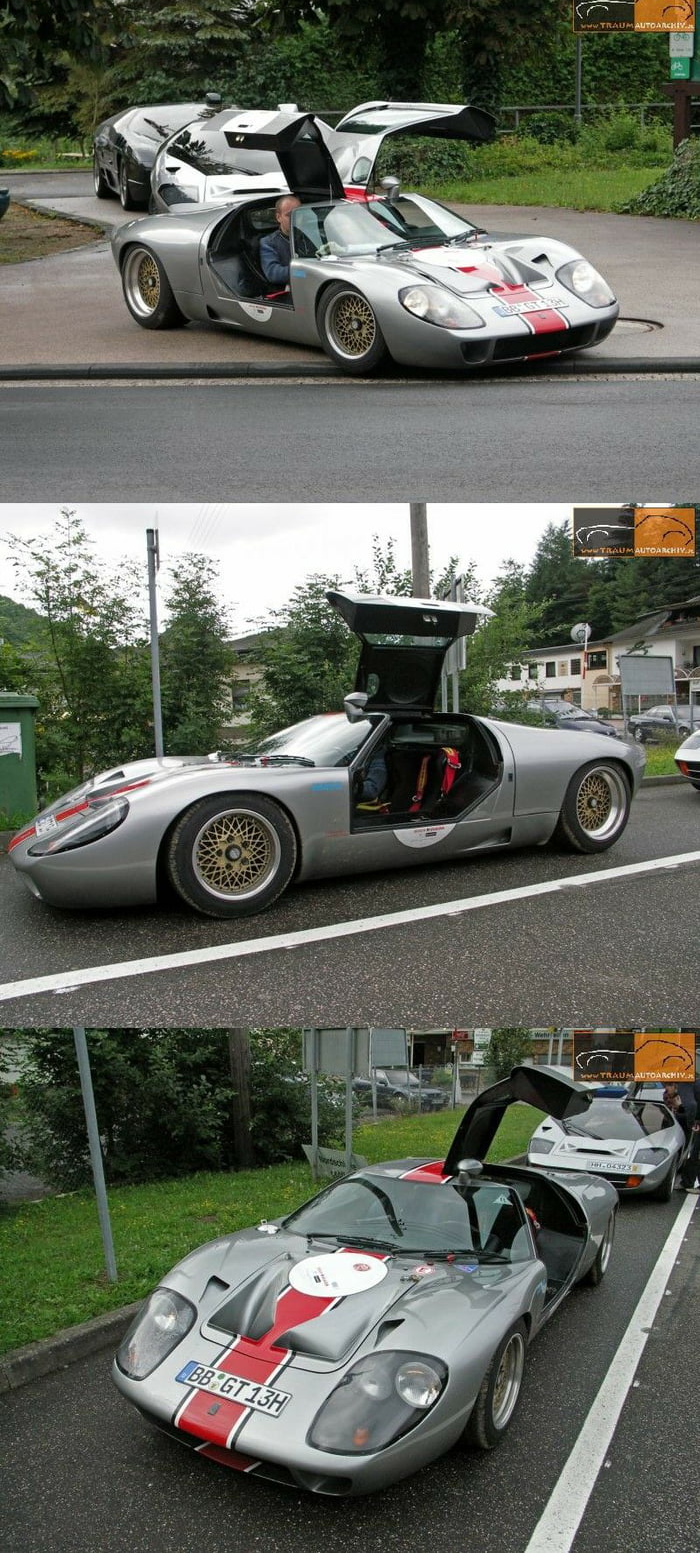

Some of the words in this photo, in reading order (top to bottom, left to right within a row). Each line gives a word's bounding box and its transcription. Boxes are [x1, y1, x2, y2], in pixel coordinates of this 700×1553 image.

[187, 1367, 215, 1386] BB
[219, 1377, 250, 1397] GT
[244, 1386, 288, 1413] 13H
